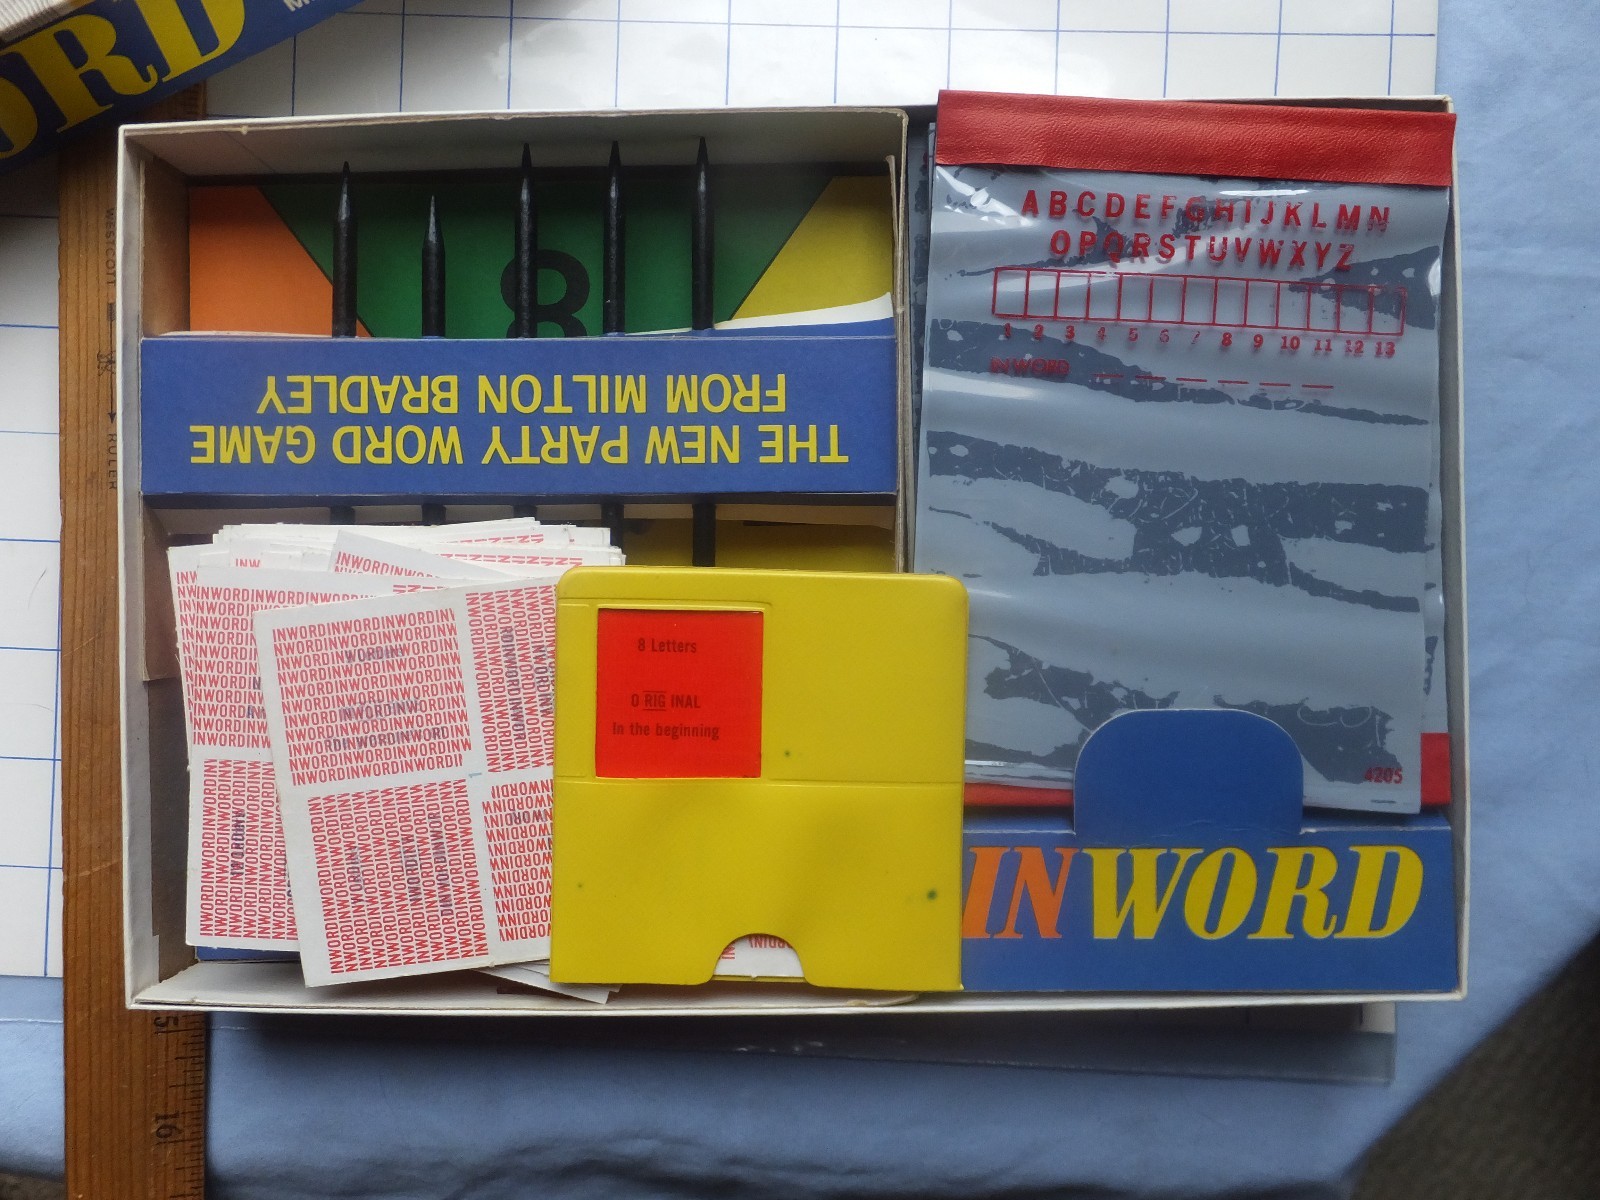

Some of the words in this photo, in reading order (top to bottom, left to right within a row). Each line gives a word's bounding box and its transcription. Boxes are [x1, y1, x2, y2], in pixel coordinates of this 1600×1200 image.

[1005, 323, 1011, 338] 1
[1035, 324, 1043, 340] 2
[1066, 326, 1075, 340] 3
[1129, 327, 1138, 343] 5
[1160, 329, 1170, 344] 6
[1223, 333, 1233, 347] 8
[1254, 334, 1264, 349] 9
[1281, 335, 1300, 350] 10
[1314, 339, 1332, 352] 11
[1344, 340, 1364, 355] 12
[1376, 341, 1396, 356] 13
[256, 374, 459, 415] BRADLEY
[479, 373, 647, 414] MILTON
[666, 373, 787, 414] FROM
[190, 424, 317, 465] GAME
[332, 424, 463, 465] WORD
[482, 425, 629, 464] PARTY
[645, 425, 741, 464] NEW
[758, 424, 849, 464] THE
[638, 638, 645, 652] 8
[651, 639, 697, 653] Letters
[644, 694, 666, 708] RIG
[671, 694, 700, 708] INAL
[613, 722, 624, 735] In
[630, 723, 650, 736] the
[656, 723, 720, 740] beginning
[961, 845, 1424, 940] INWORD
[155, 1110, 182, 1138] 16
